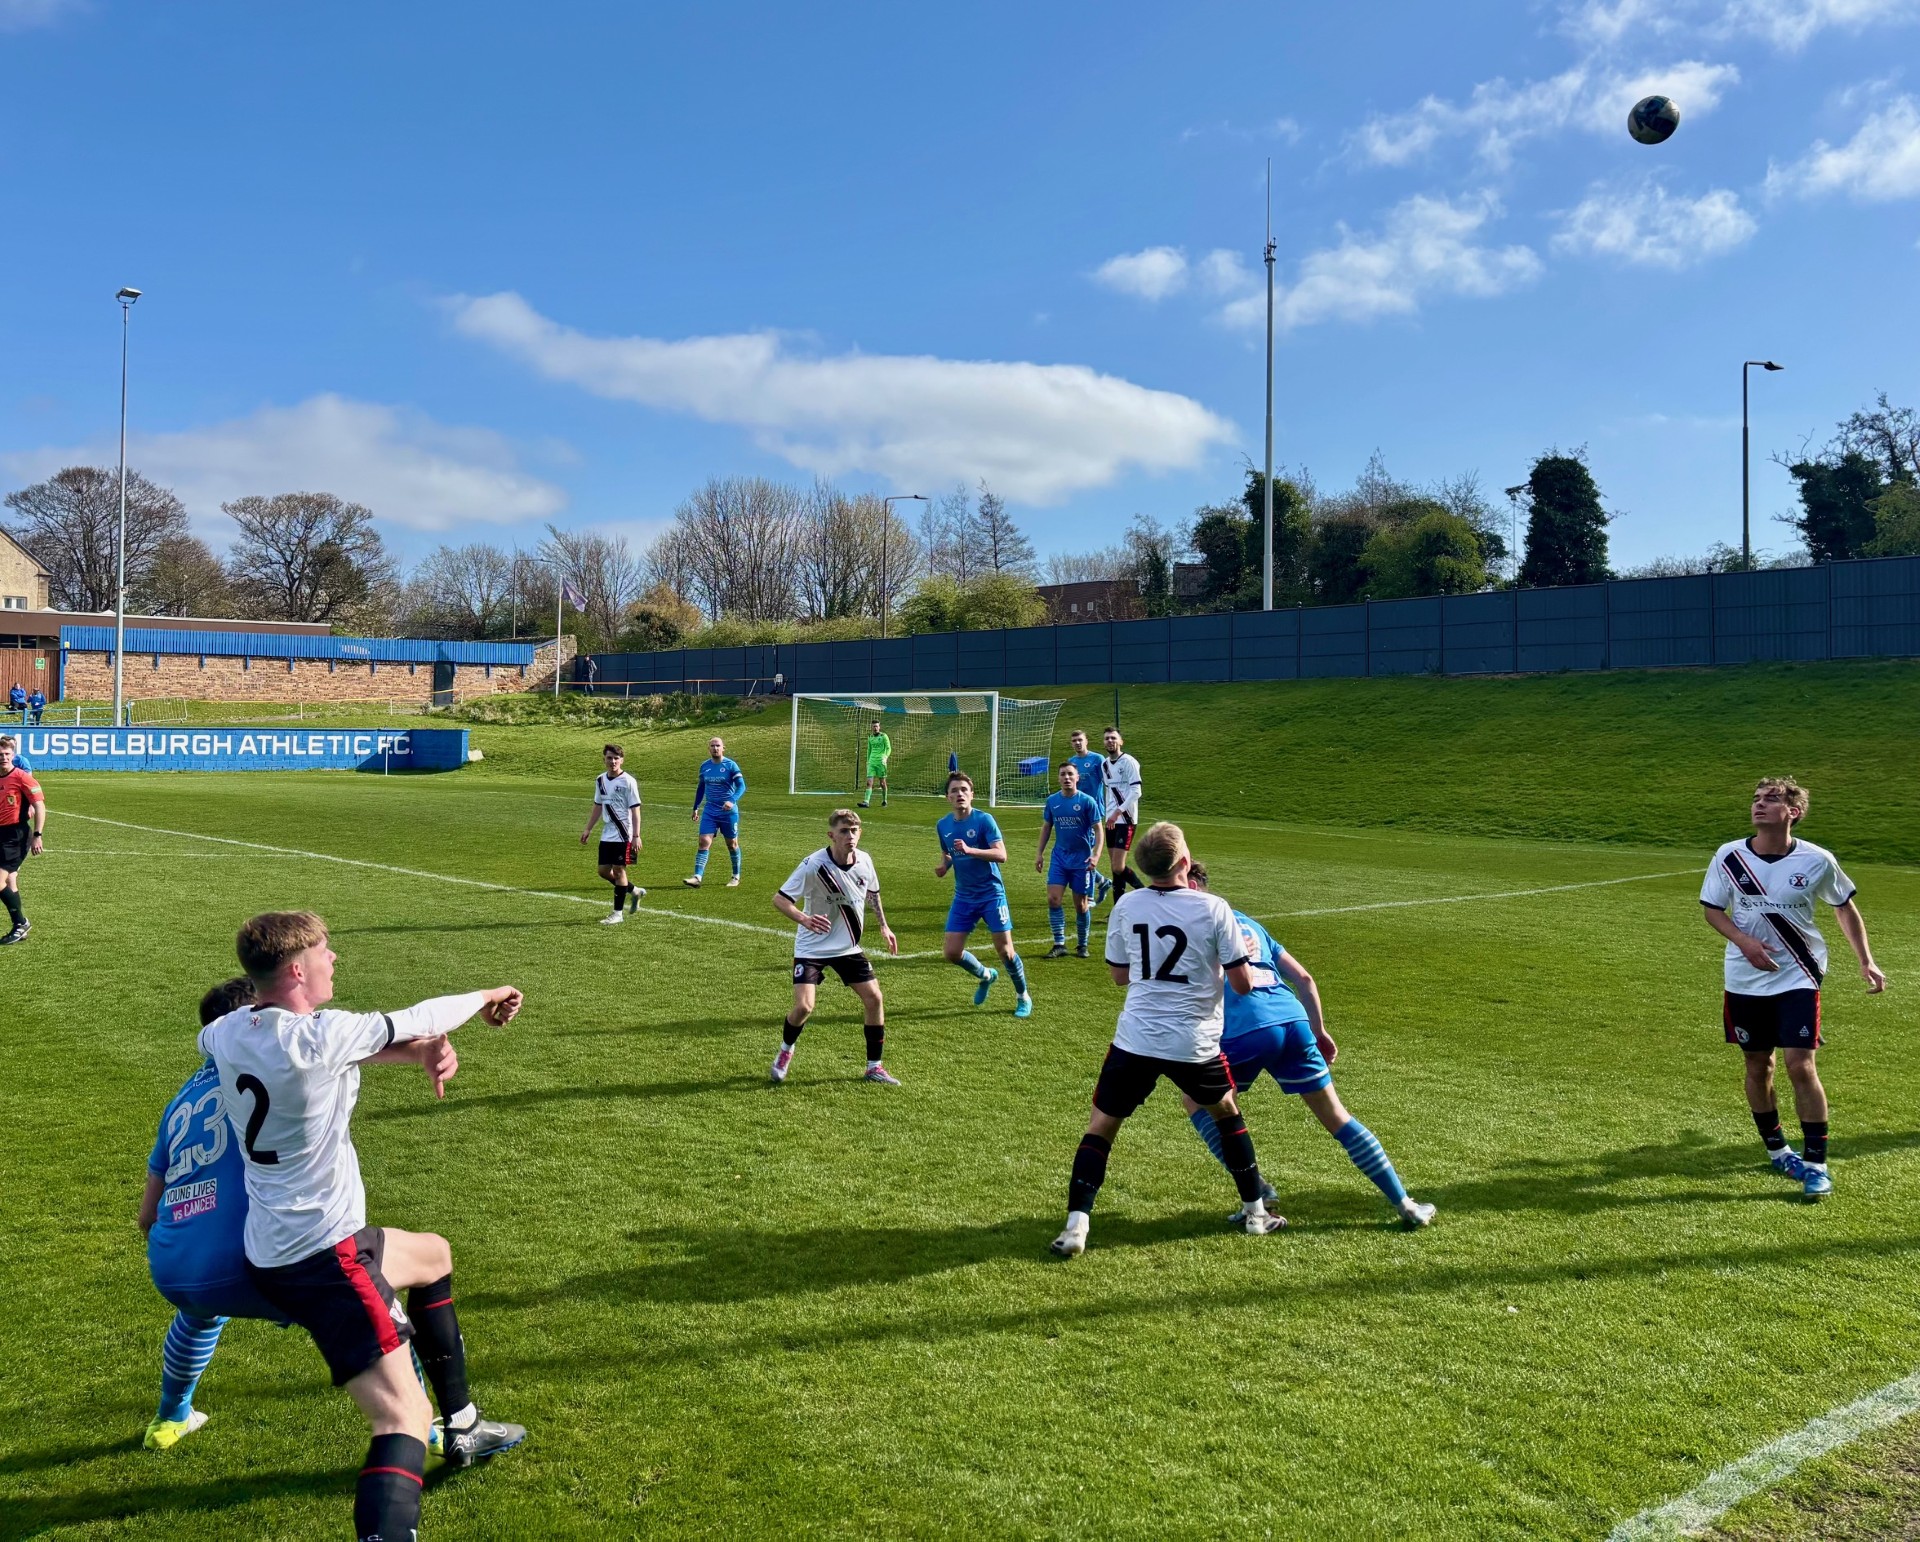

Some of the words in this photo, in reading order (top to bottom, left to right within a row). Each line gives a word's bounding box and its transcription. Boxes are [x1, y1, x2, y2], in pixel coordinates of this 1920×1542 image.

[238, 734, 371, 755] ATHLETIC
[378, 735, 414, 755] F.C.
[1133, 923, 1189, 984] 12
[165, 1086, 228, 1184] 23
[236, 1074, 280, 1165] 2
[166, 1186, 191, 1205] YOUNG
[193, 1180, 216, 1198] LIVES
[184, 1195, 216, 1217] CANCER
